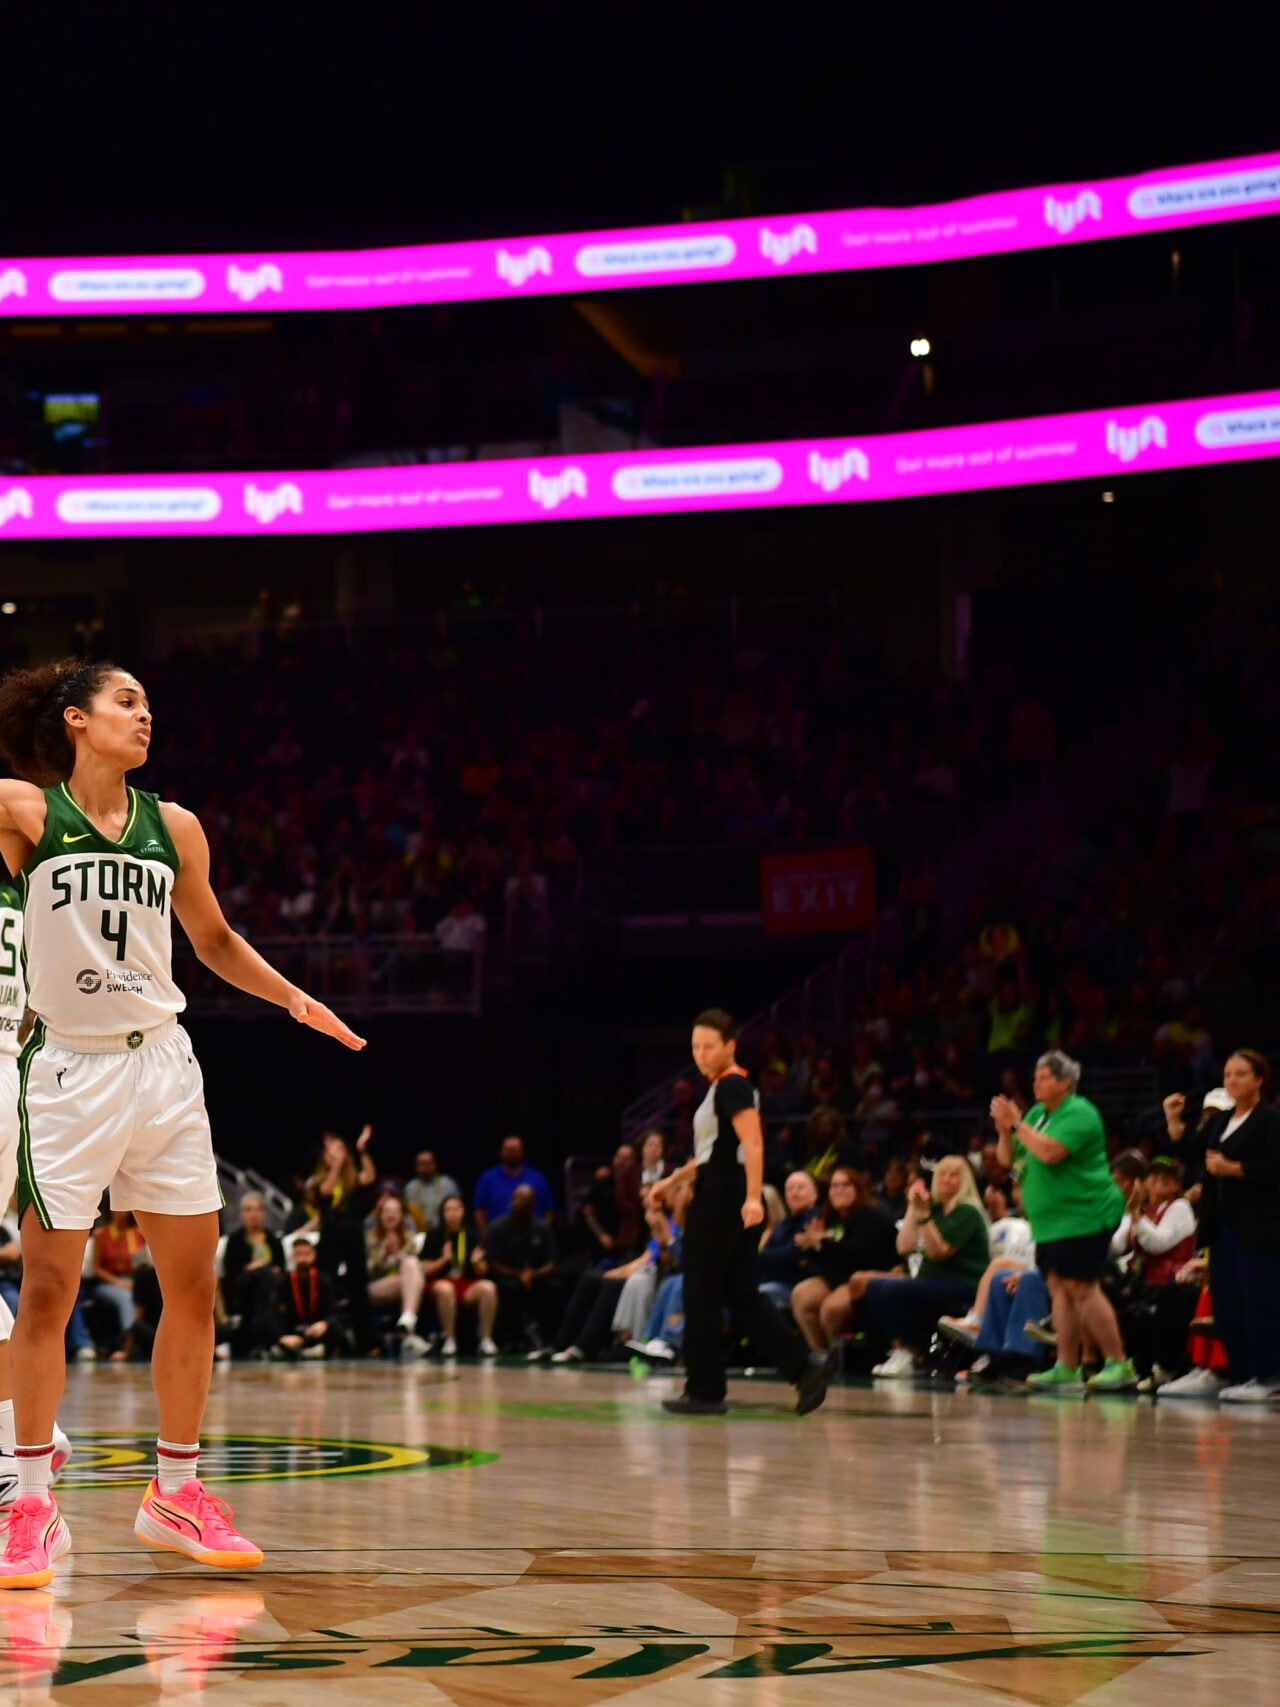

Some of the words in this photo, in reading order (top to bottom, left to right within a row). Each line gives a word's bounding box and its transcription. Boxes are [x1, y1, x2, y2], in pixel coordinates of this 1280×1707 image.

[52, 859, 166, 917] STORM
[771, 880, 861, 916] EXIT
[101, 909, 128, 961] 4
